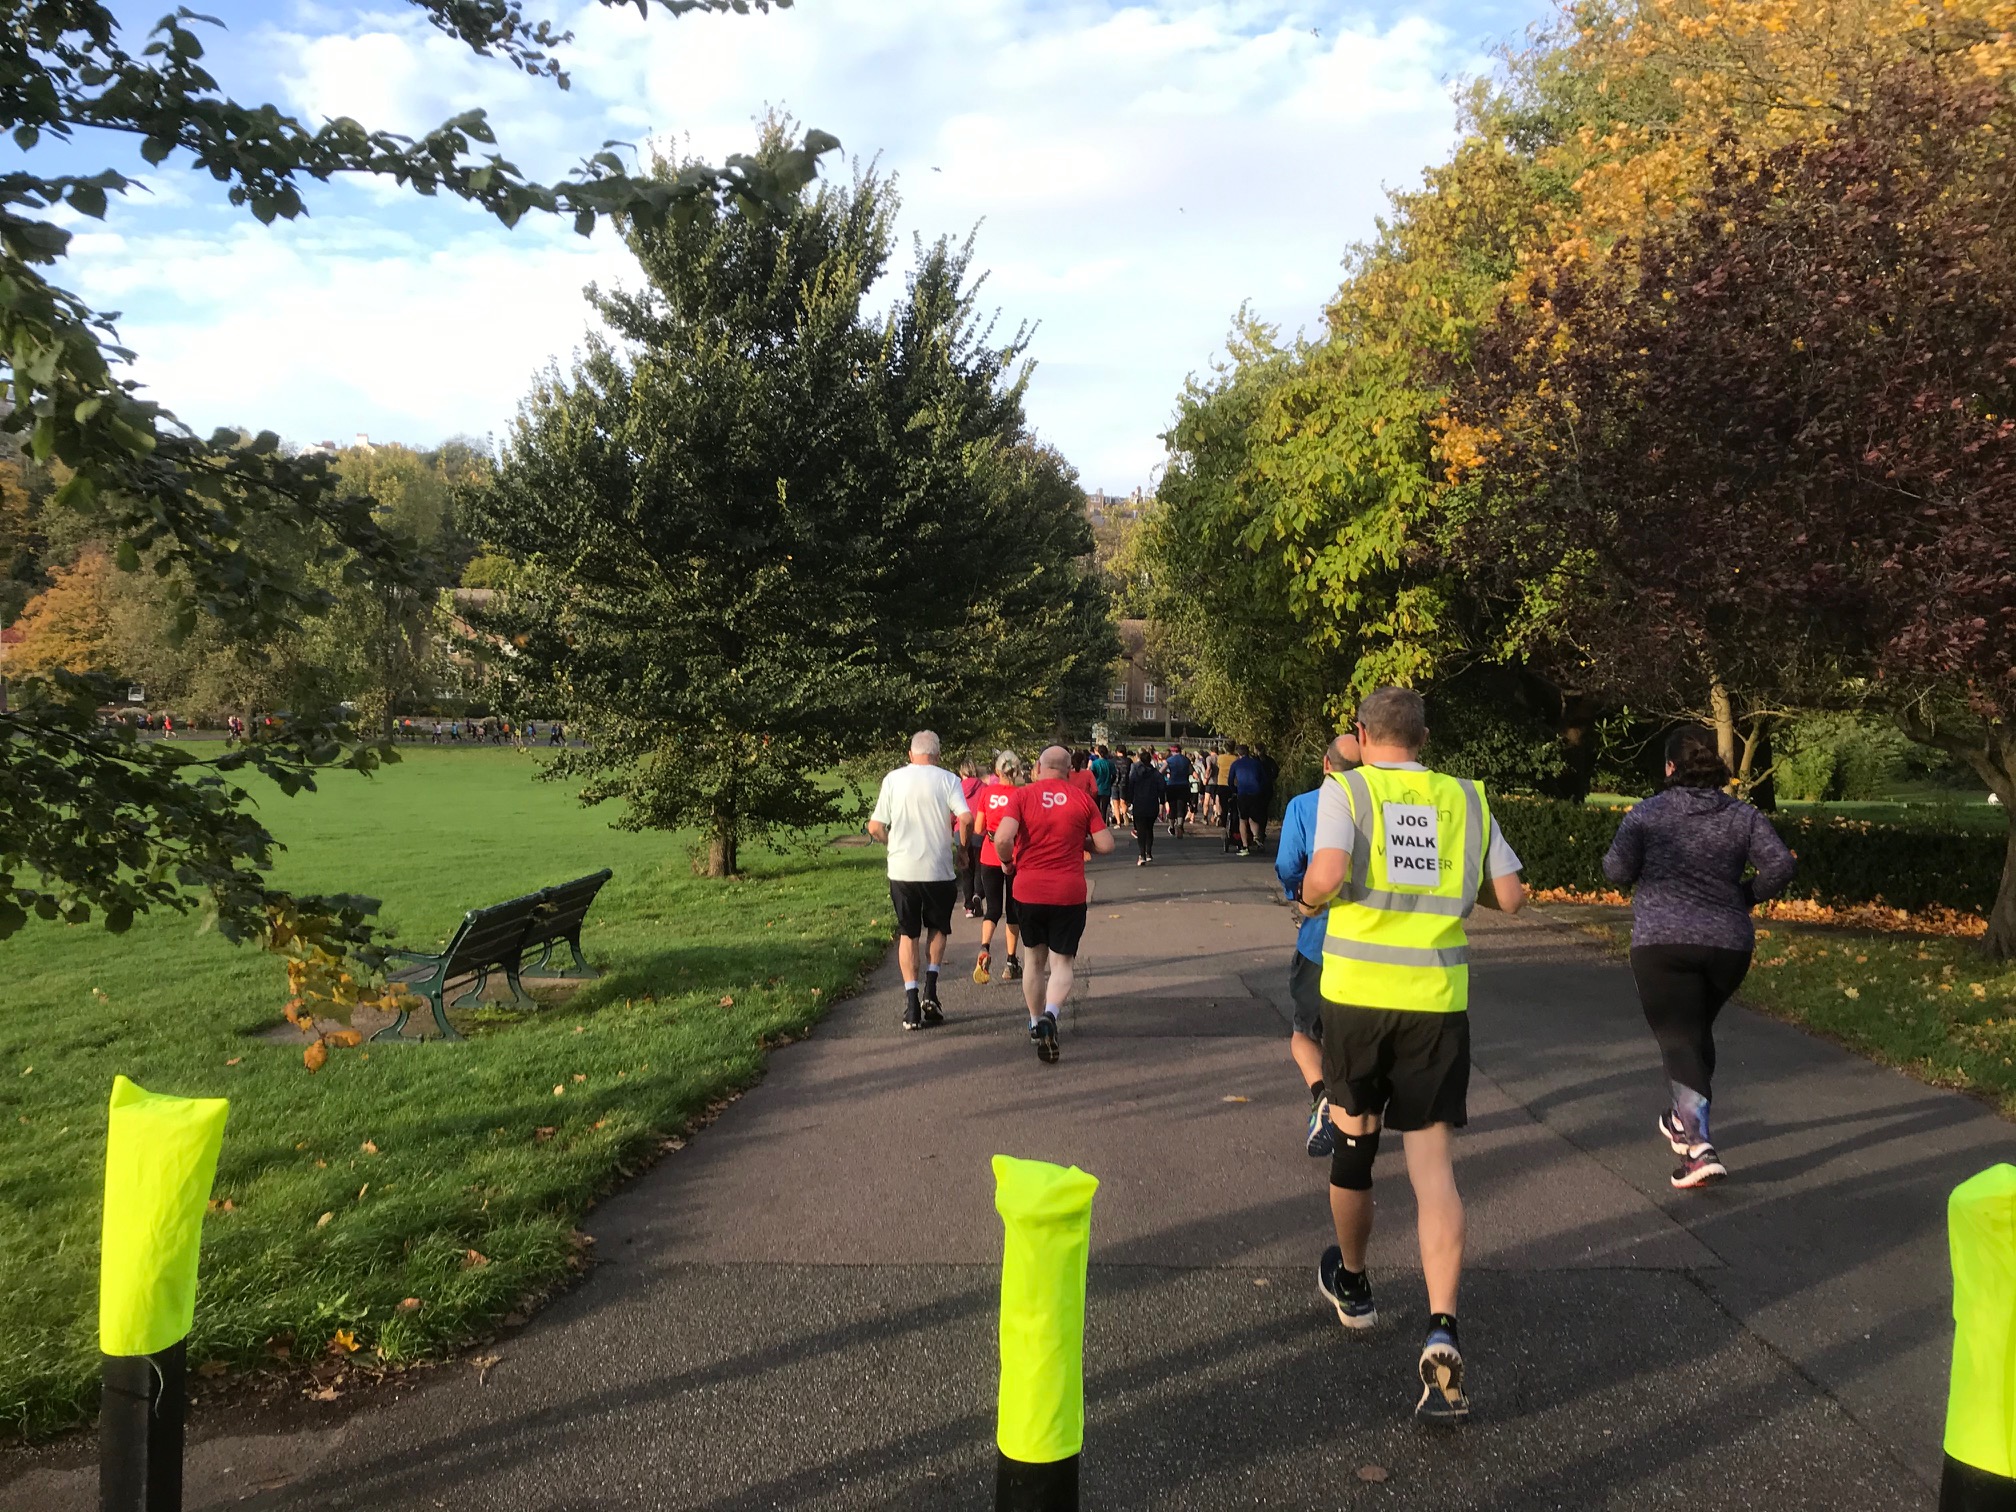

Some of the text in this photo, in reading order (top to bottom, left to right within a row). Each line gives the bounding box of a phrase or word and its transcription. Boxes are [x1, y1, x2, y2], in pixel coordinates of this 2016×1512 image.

[989, 794, 1009, 809] 50
[1042, 791, 1067, 808] 50
[1397, 815, 1428, 827] JOG
[1391, 834, 1436, 848] WALK
[1394, 856, 1436, 870] PACE
